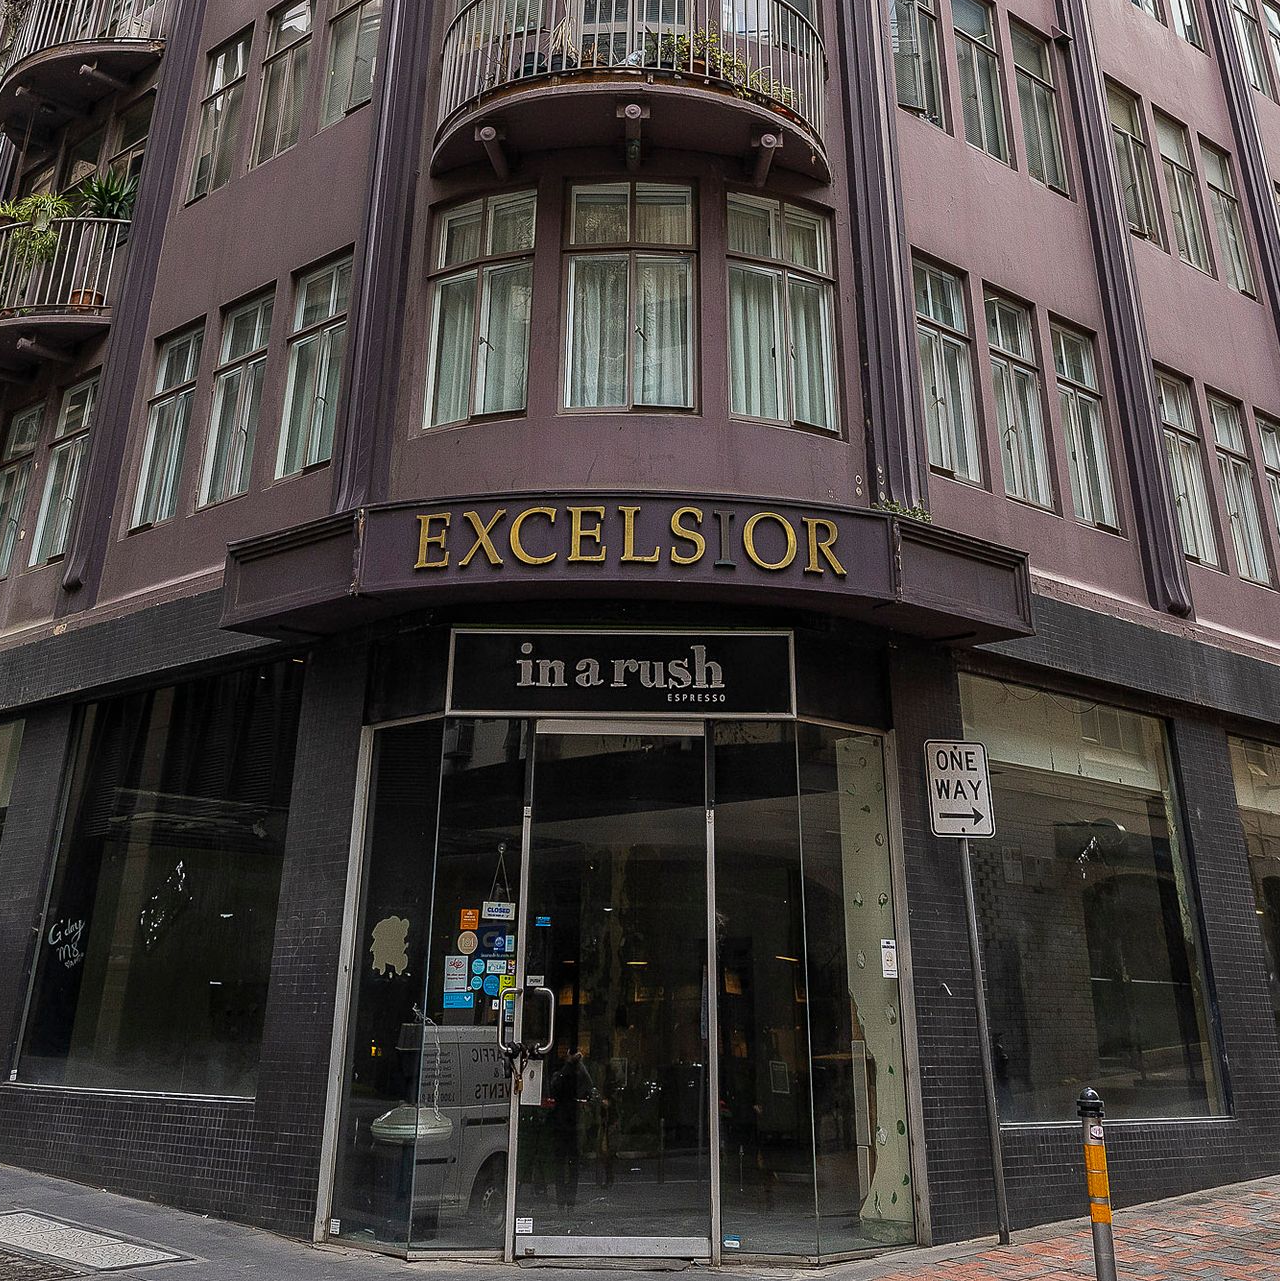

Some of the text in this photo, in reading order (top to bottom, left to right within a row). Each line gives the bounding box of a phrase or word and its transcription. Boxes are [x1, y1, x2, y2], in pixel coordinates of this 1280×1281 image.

[414, 506, 848, 576] EXCELSIOR
[516, 642, 726, 689] in a rush
[667, 693, 726, 703] ESPRESSO
[936, 750, 978, 771] ONE
[934, 778, 982, 801] WAY
[487, 906, 511, 914] CLOSED
